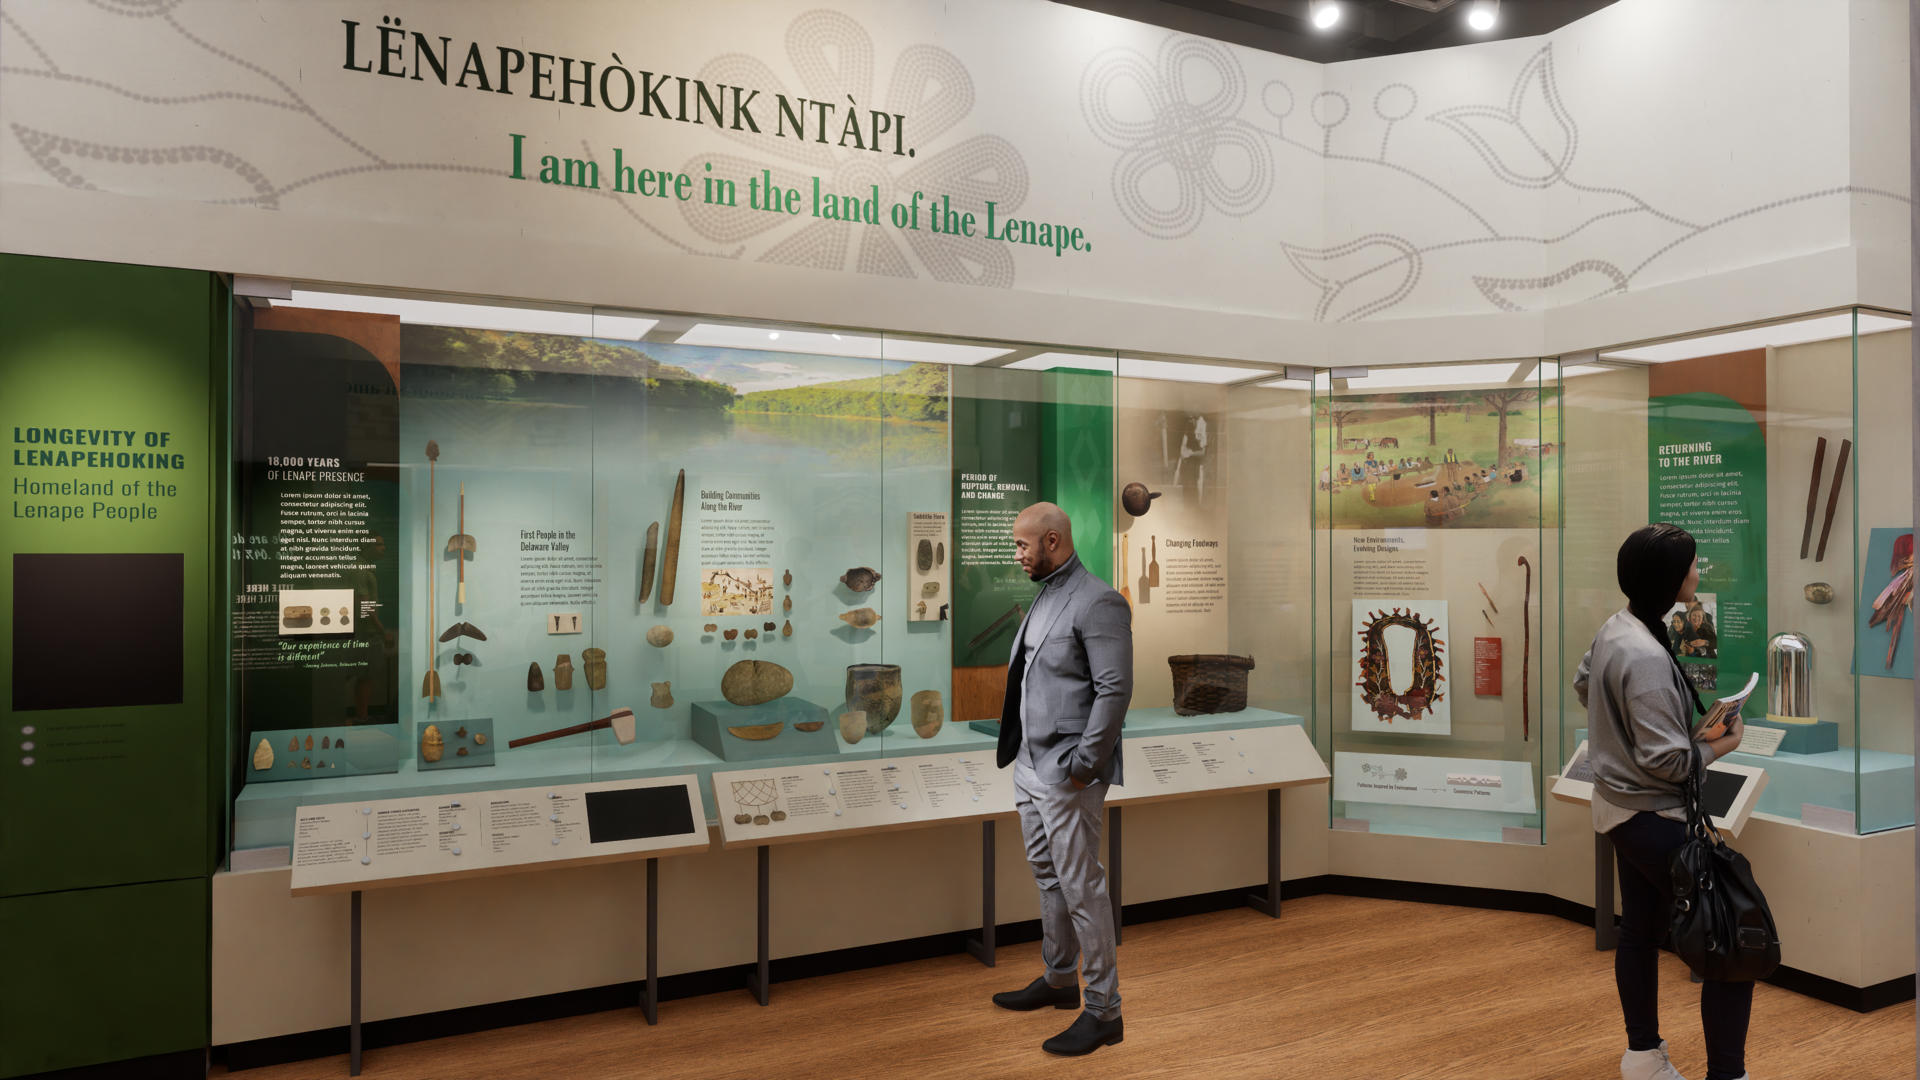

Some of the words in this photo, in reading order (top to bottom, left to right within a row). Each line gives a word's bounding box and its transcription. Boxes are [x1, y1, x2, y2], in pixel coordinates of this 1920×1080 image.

[341, 15, 761, 133] LËNAPEHÒKINK
[775, 94, 915, 158] NTÀPI.
[509, 133, 526, 180] I
[539, 155, 600, 190] am
[612, 148, 692, 201] here
[703, 162, 737, 207] in
[748, 169, 801, 215] the
[812, 176, 880, 225] land
[891, 191, 923, 230] of
[929, 195, 976, 237] the
[984, 201, 1092, 257] Lenape.
[14, 427, 136, 446] LONGEVITY
[144, 432, 170, 448] OF
[1659, 441, 1712, 455] RETURNING
[14, 449, 185, 470] LENAPEHOKING
[268, 456, 304, 467] 18,000
[307, 457, 340, 468] YEARS
[1659, 458, 1670, 468] TO
[1673, 457, 1690, 467] THE
[1693, 454, 1722, 465] RIVER
[268, 470, 280, 481] OF
[283, 471, 317, 481] LENAPE
[319, 472, 365, 482] PRESENCE
[961, 473, 987, 481] PERIOD
[14, 477, 113, 496] Homeland
[122, 480, 140, 496] of
[147, 480, 177, 497] the
[997, 484, 1030, 492] REMOVAL,
[701, 490, 724, 500] Building
[725, 491, 760, 500] Communities
[14, 501, 84, 522] Lenape
[93, 501, 157, 522] People
[701, 502, 716, 512] Along
[718, 502, 727, 511] the
[728, 503, 742, 511] River
[520, 530, 534, 540] First
[536, 530, 557, 541] People
[559, 530, 564, 539] in
[566, 530, 576, 539] the
[520, 542, 549, 551] Delaware
[551, 542, 570, 552] Valley
[1166, 539, 1192, 549] Changing
[1192, 539, 1218, 549] Foodways
[1353, 545, 1376, 553] Evolving
[1377, 545, 1399, 553] Designs
[299, 641, 340, 652] experience
[342, 640, 352, 649] of
[352, 640, 369, 648] time
